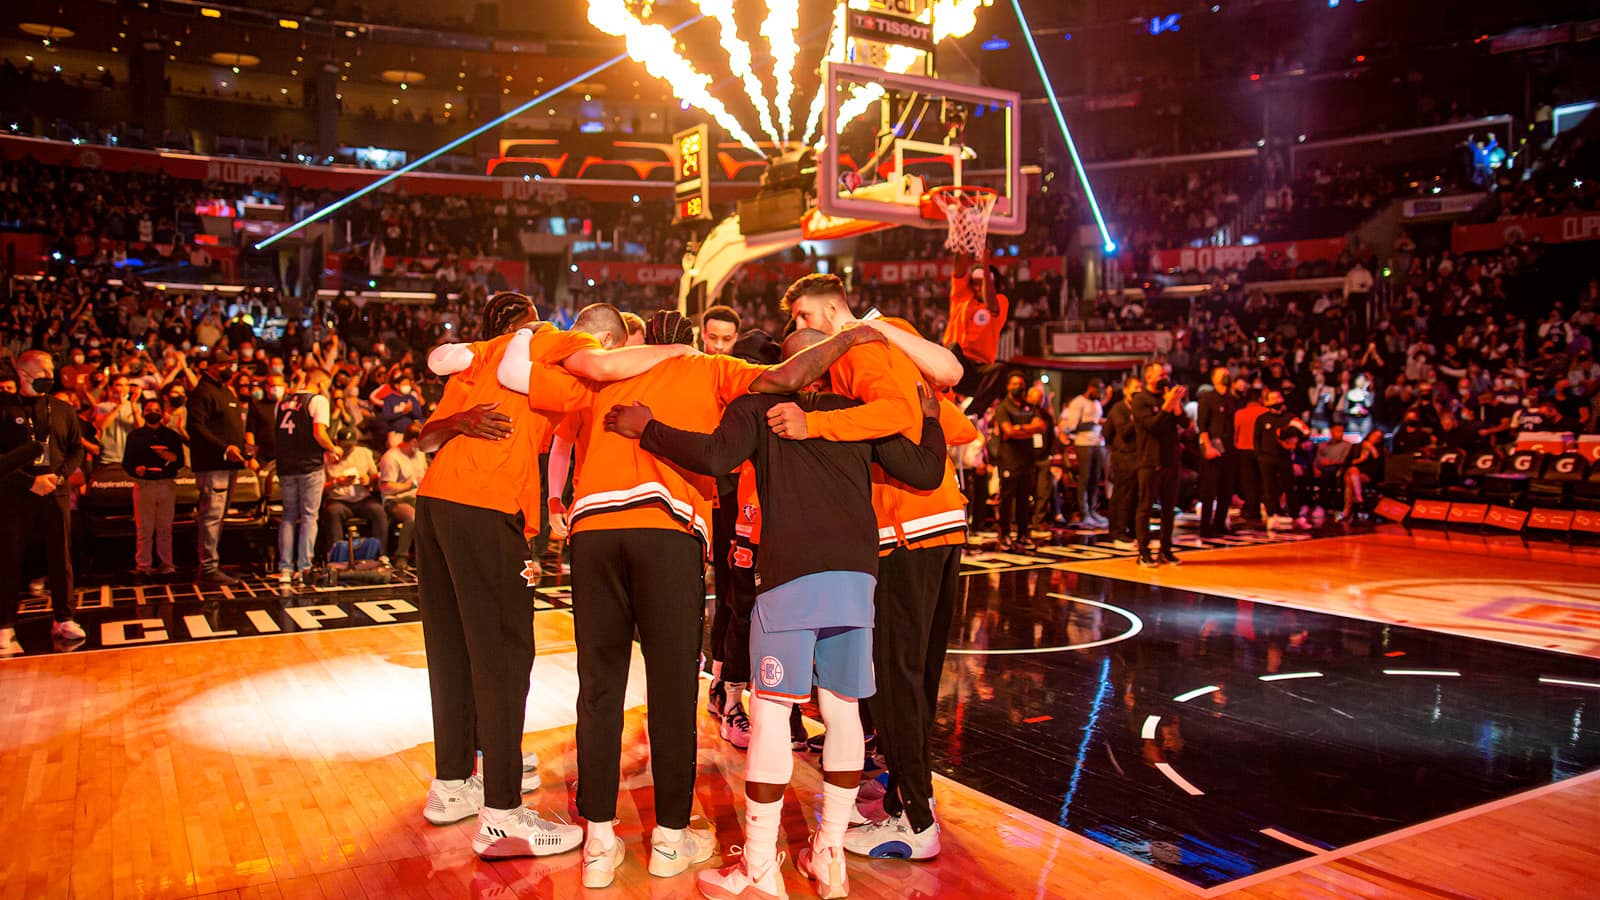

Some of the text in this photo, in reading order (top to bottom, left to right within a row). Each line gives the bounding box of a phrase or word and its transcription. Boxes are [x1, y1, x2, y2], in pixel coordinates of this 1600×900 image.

[876, 18, 930, 41] TISSOT
[1077, 332, 1157, 353] STAPLES
[280, 411, 295, 435] 4
[1476, 454, 1494, 469] G
[1514, 455, 1532, 471] G
[1556, 458, 1575, 473] G
[101, 599, 419, 645] CLIPP
